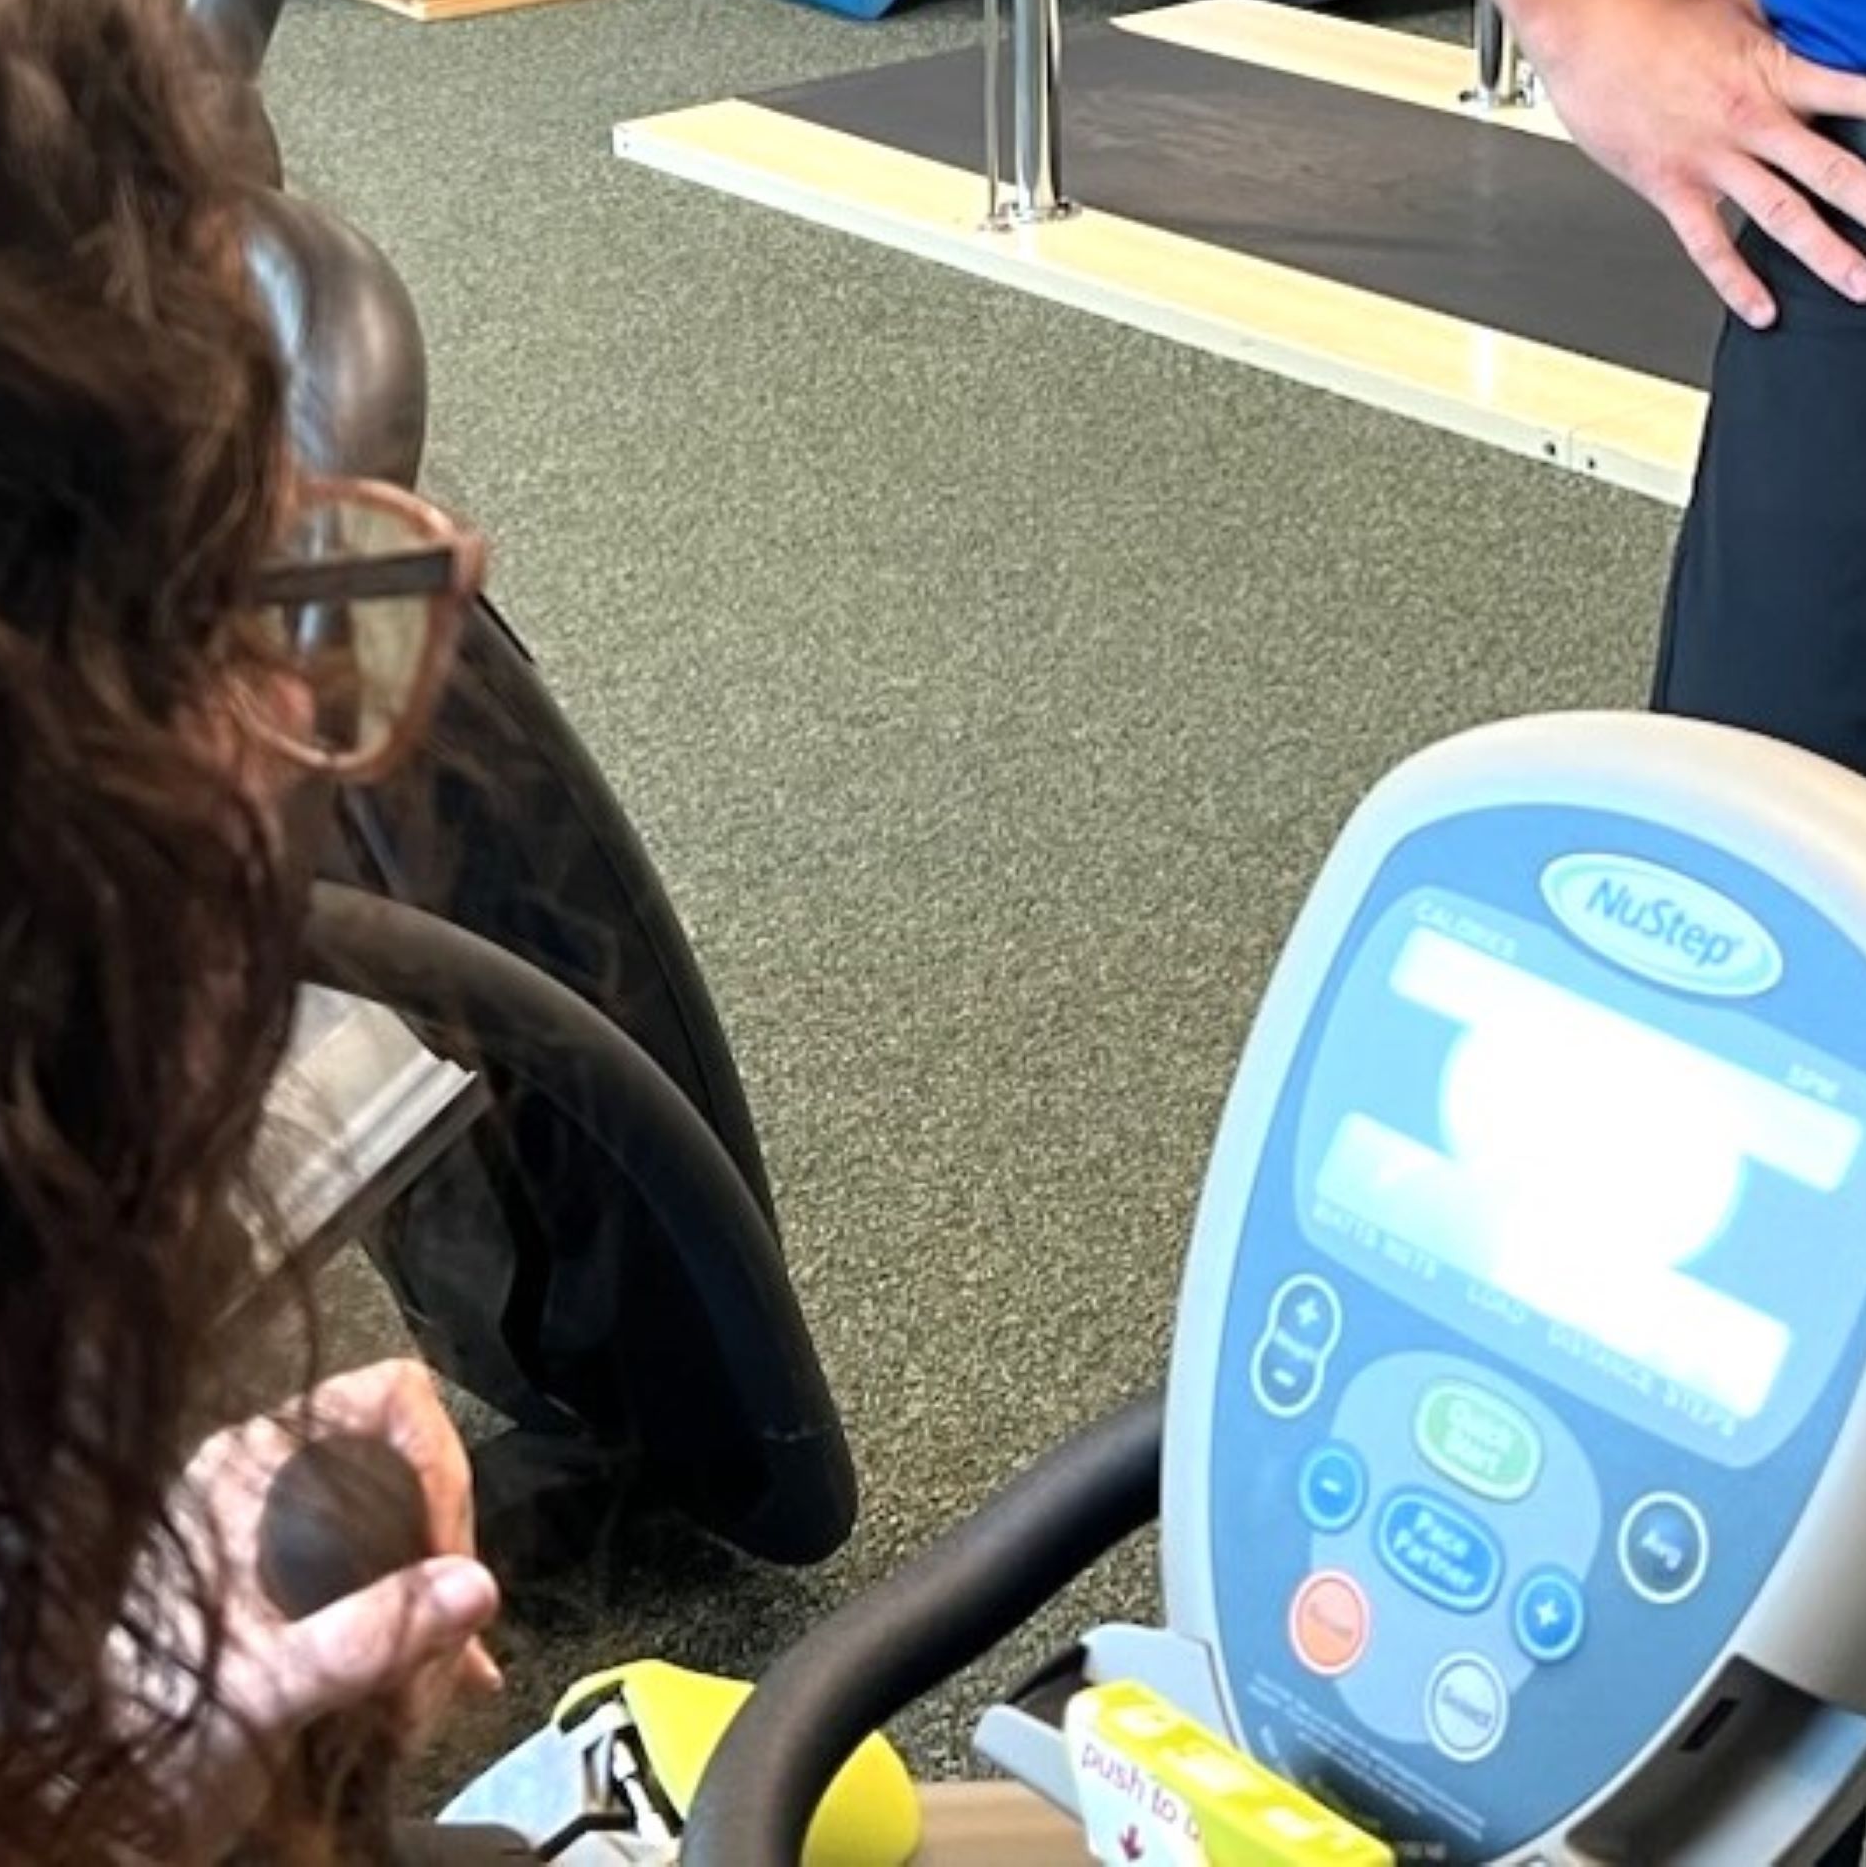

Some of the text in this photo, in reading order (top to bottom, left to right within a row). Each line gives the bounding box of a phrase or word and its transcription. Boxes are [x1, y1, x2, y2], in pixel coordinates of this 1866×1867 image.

[1583, 877, 1735, 968] NuStep
[1081, 1742, 1177, 1824] push to
